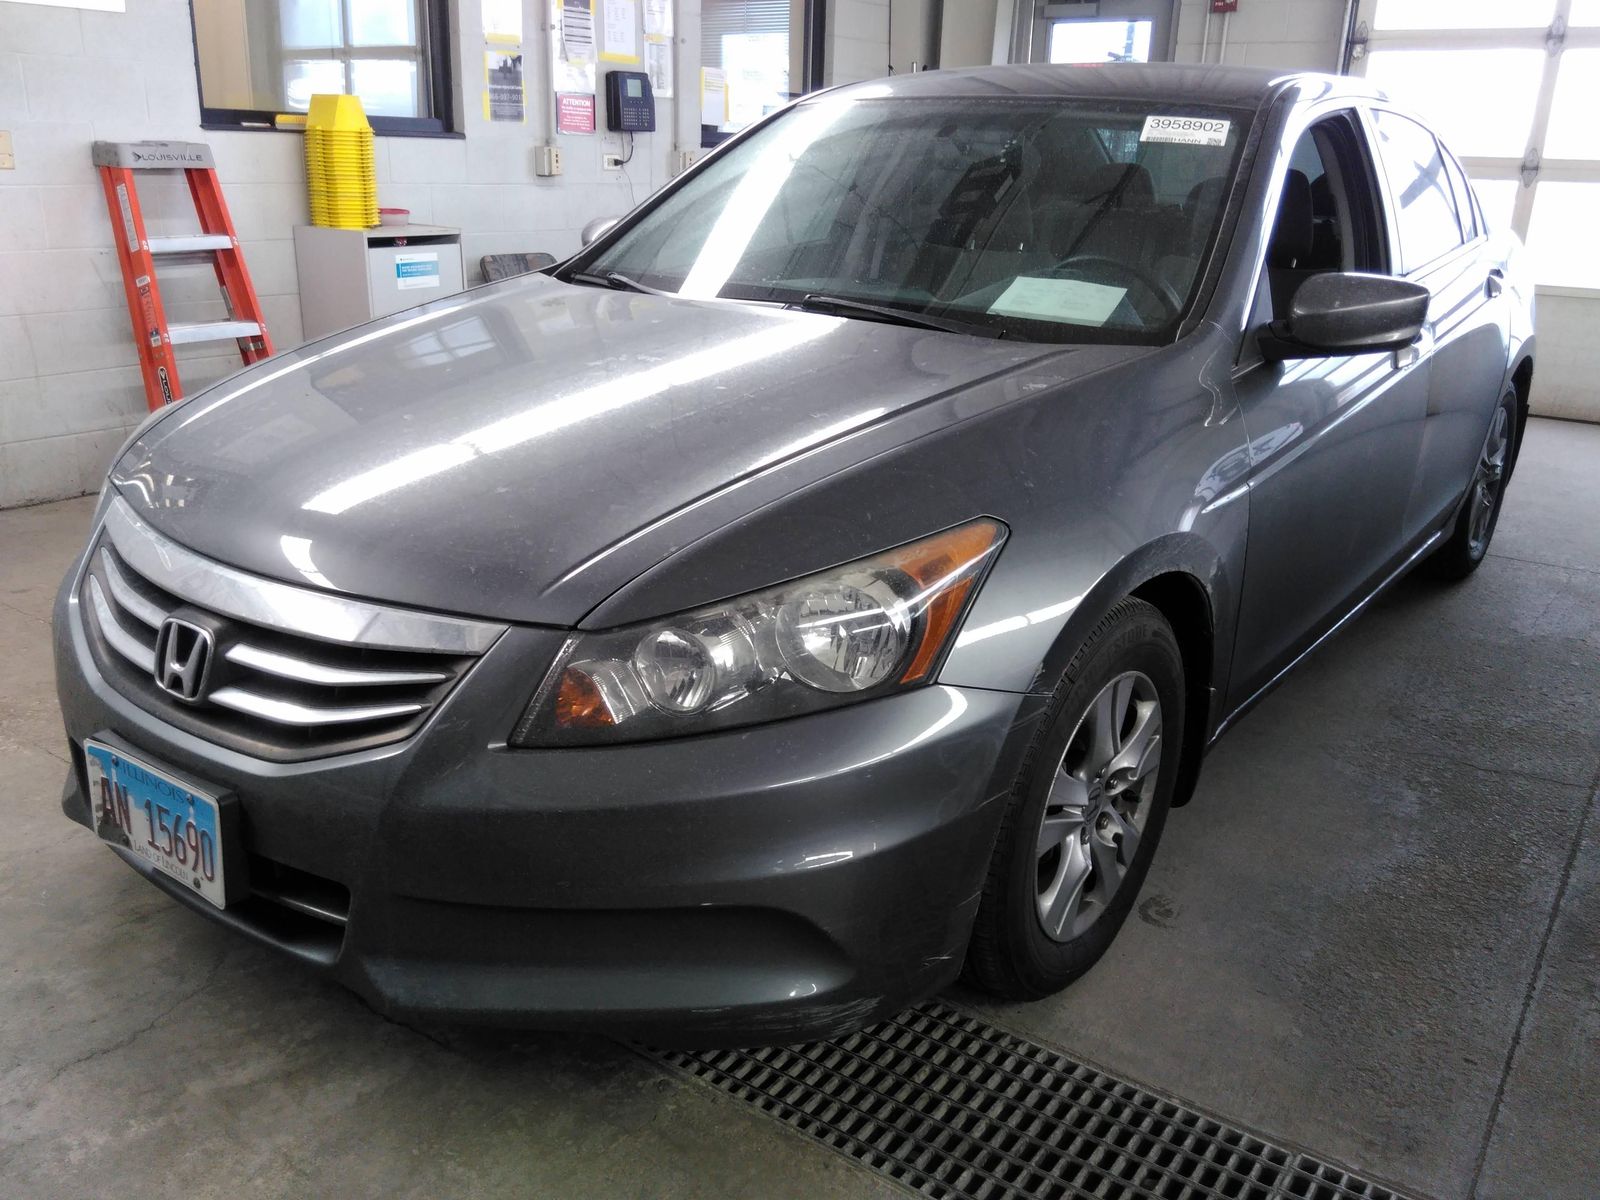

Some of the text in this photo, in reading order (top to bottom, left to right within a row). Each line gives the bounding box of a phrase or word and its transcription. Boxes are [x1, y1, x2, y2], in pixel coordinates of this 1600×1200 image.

[1149, 118, 1224, 133] 3958902
[142, 152, 203, 162] LOUISVILLE
[122, 762, 186, 804] ILLINOIS
[100, 776, 215, 882] AN 15690
